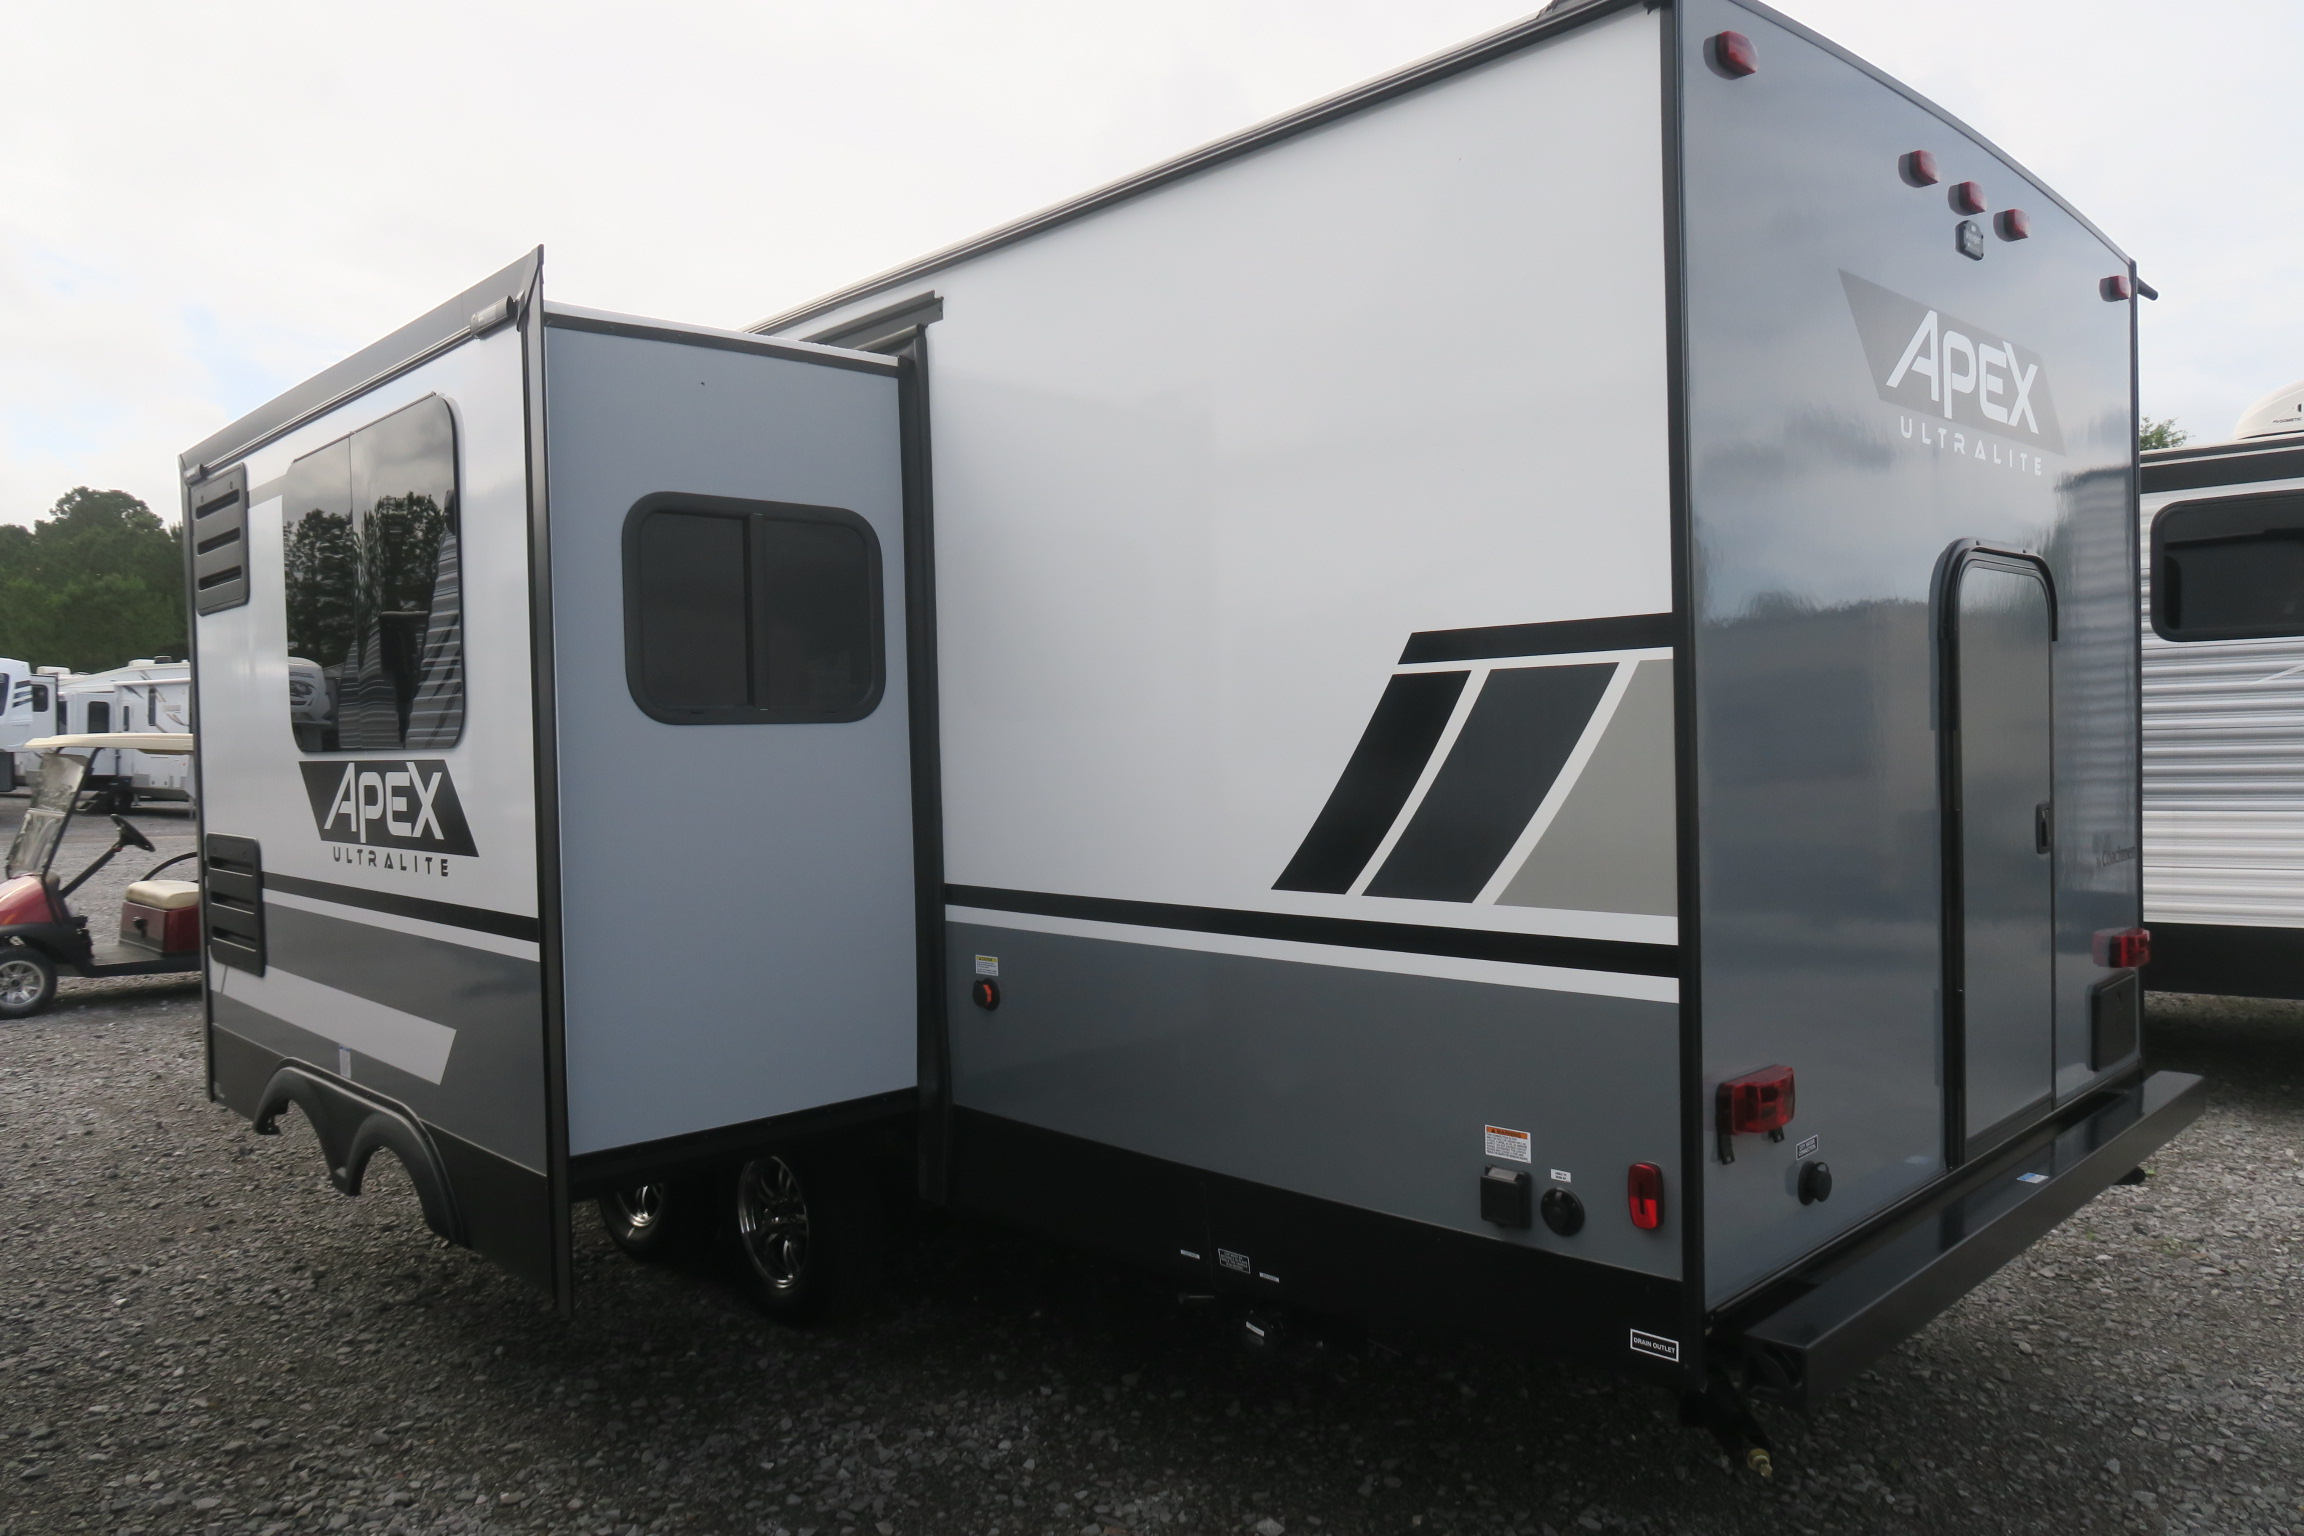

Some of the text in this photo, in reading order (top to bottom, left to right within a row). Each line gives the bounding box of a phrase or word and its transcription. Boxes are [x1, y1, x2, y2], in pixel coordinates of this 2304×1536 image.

[1885, 309, 2040, 435] APEX
[1900, 415, 2042, 476] ULTRALITE
[324, 761, 445, 844] APEX
[333, 846, 449, 877] ULTRALITE
[1633, 1337, 1676, 1354] DRAIN OUTLET
